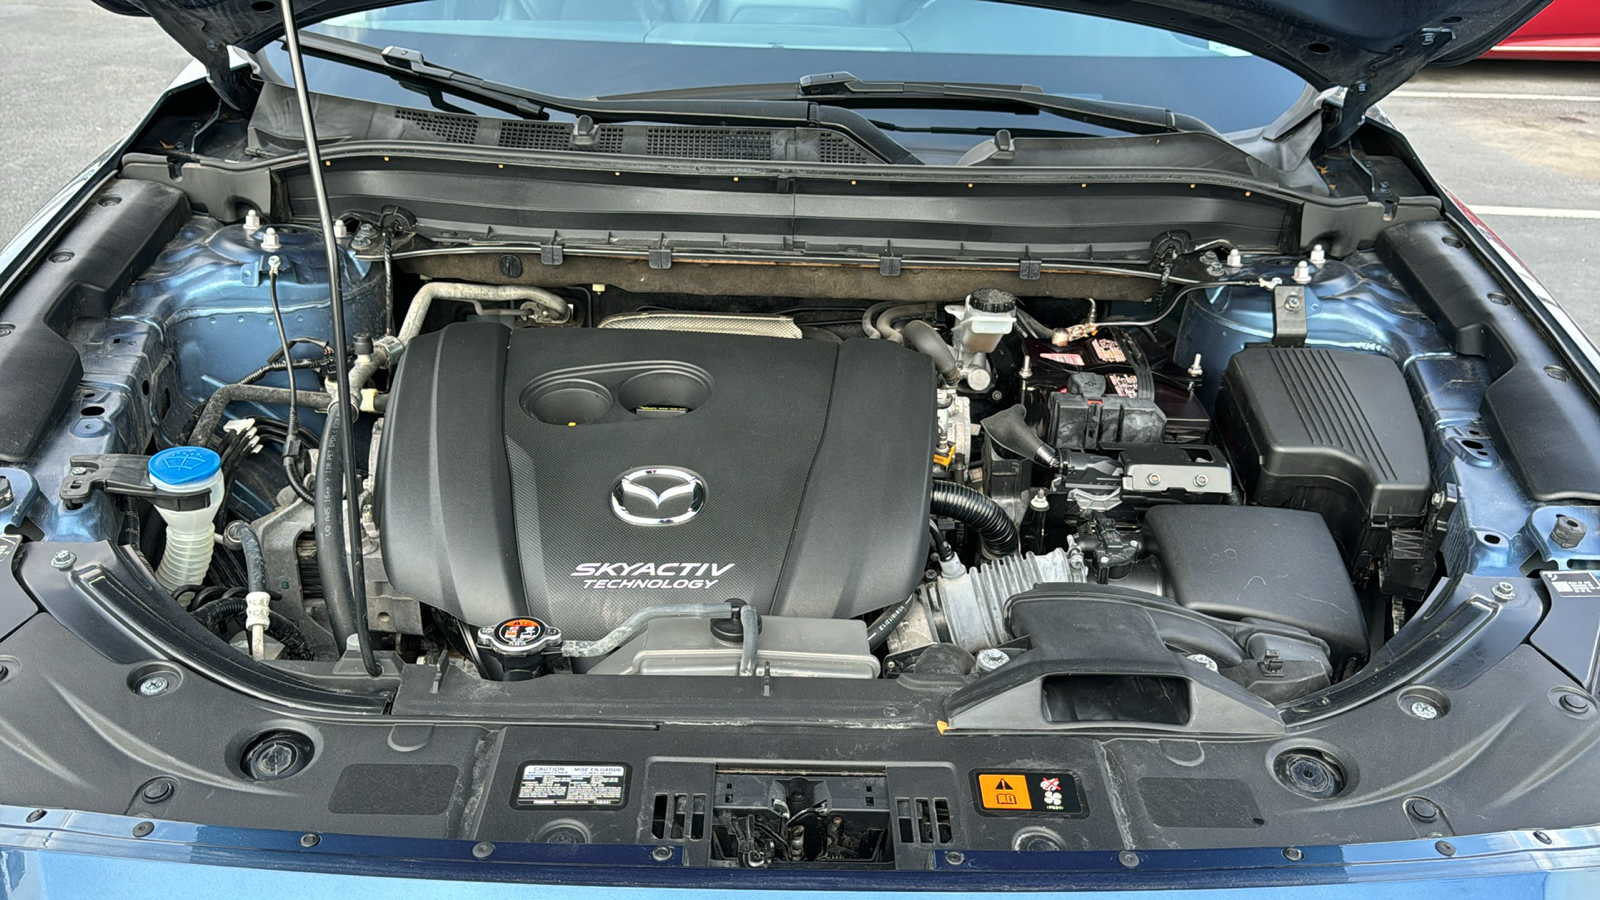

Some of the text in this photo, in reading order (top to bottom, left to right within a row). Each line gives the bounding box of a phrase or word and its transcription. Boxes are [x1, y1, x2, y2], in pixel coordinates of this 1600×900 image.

[326, 449, 334, 461] PET
[570, 562, 736, 577] SKYACTIV
[583, 579, 719, 589] TECHNOLOGY
